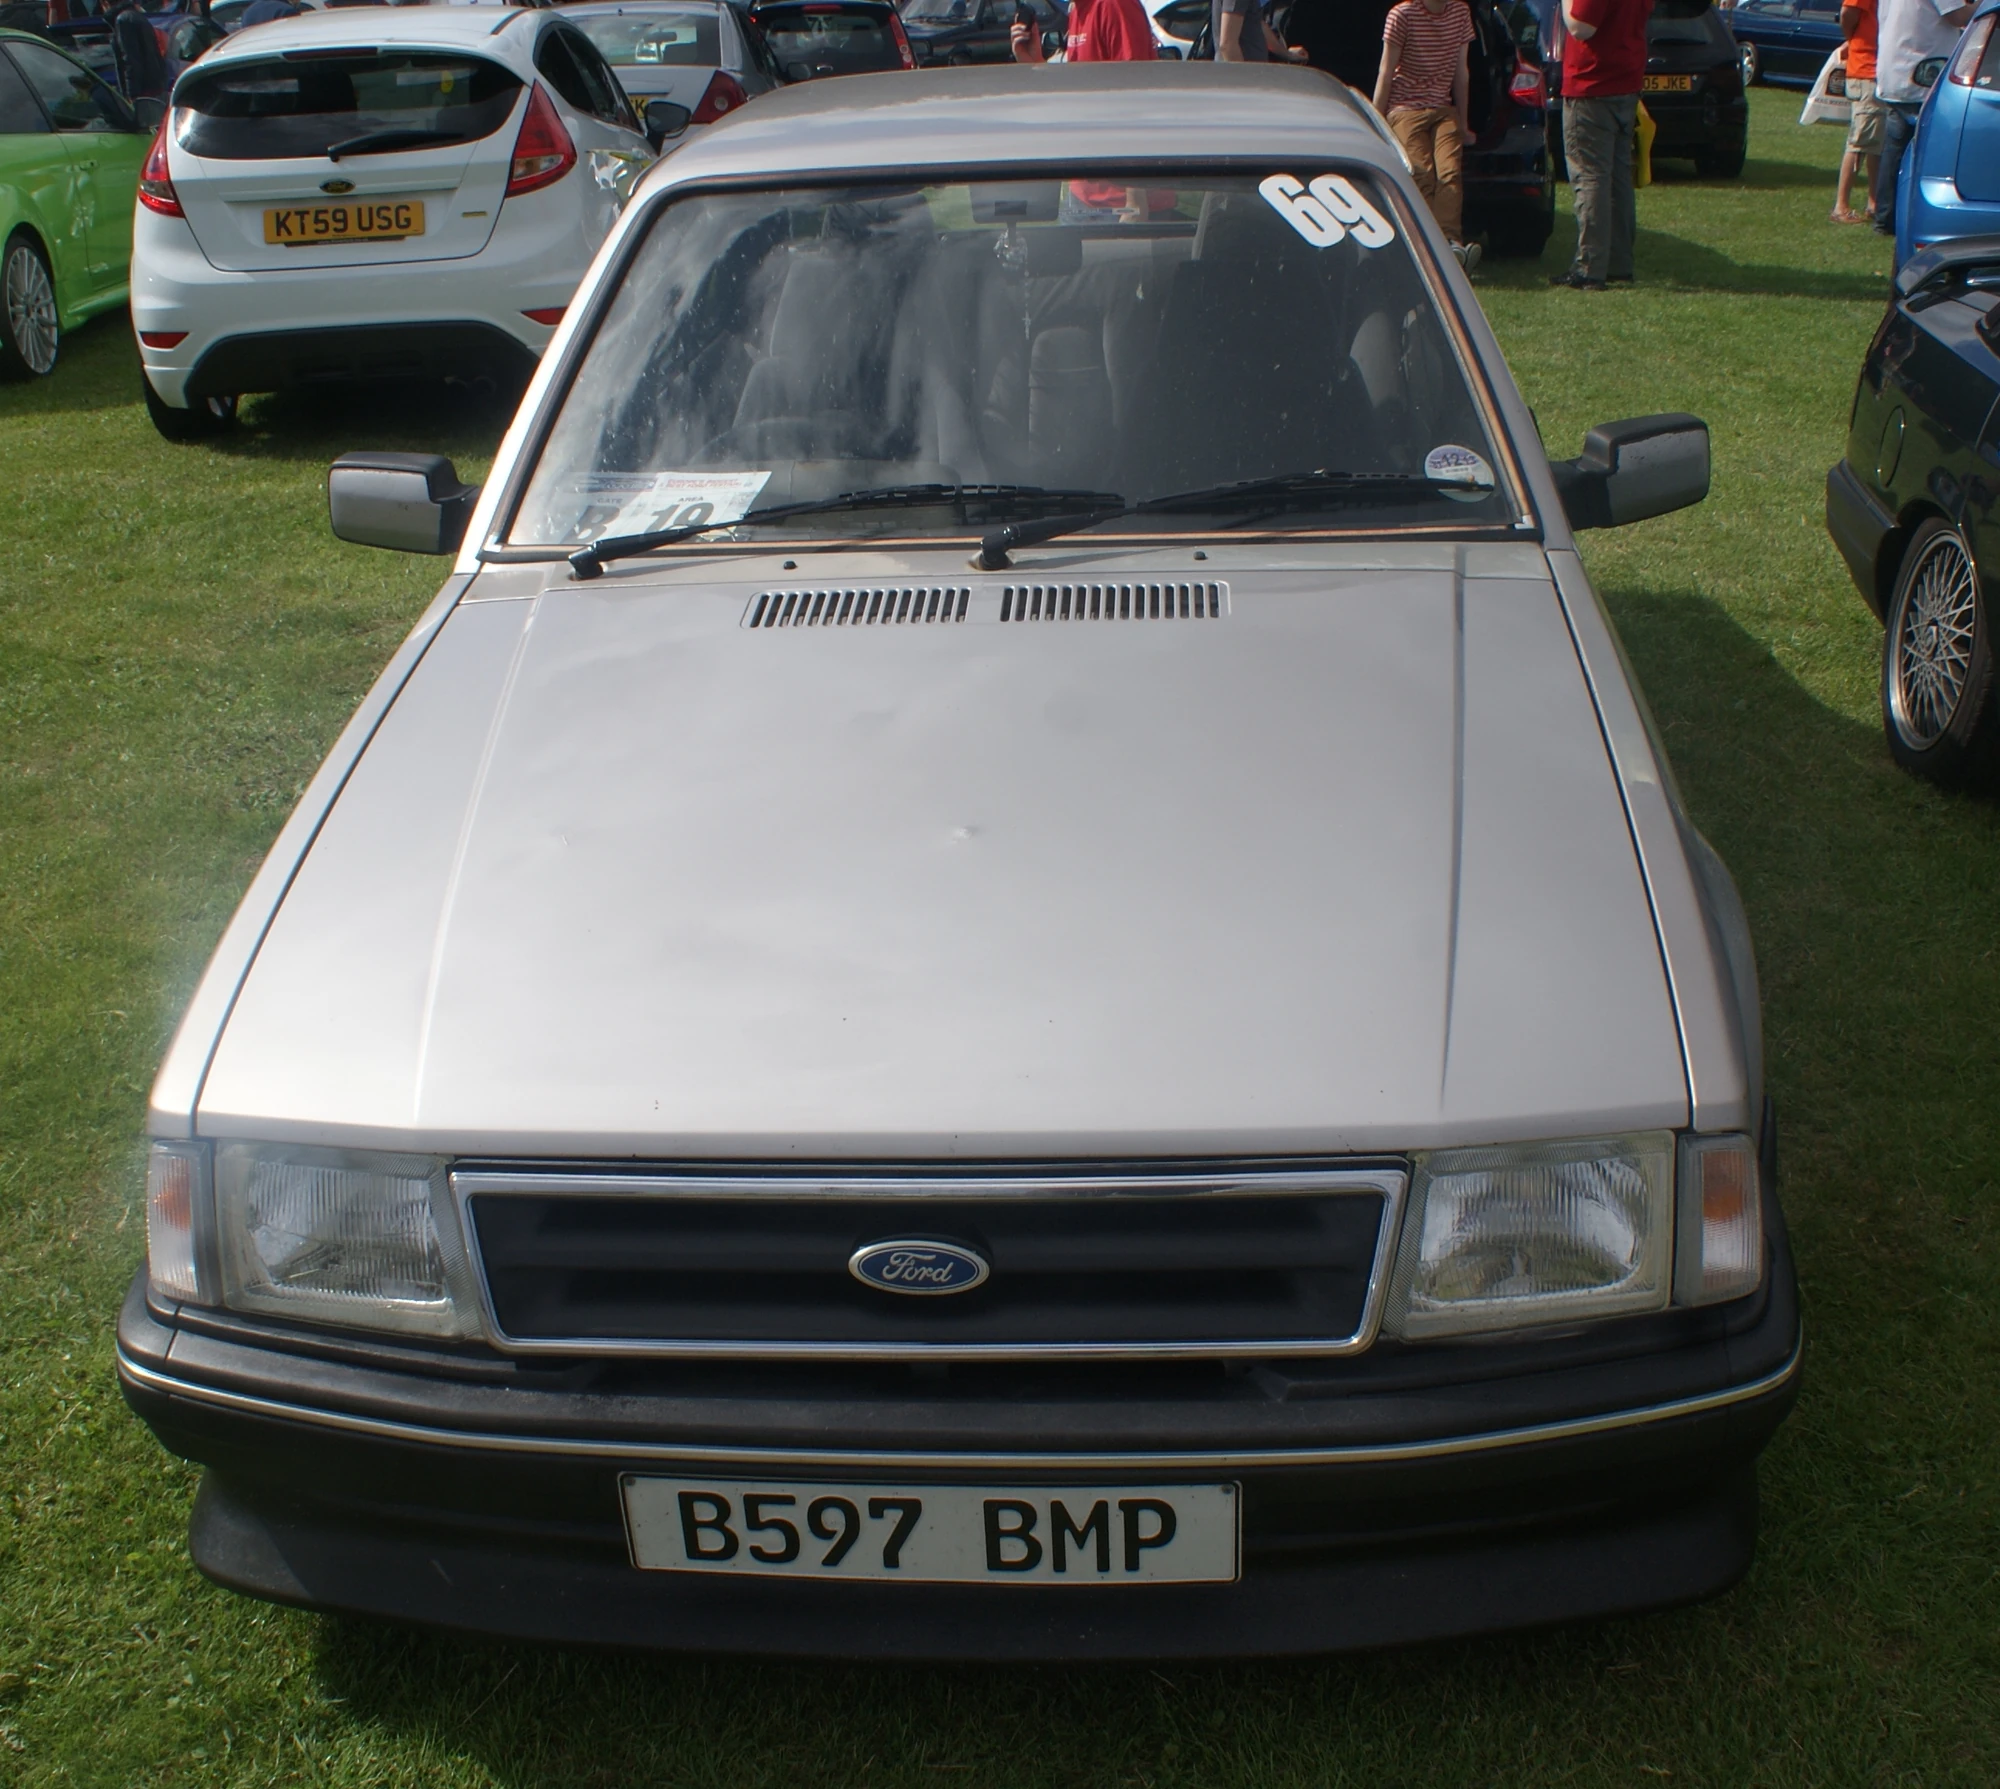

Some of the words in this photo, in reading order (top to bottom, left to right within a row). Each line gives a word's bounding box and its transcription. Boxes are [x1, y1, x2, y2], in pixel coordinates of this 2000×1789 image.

[1663, 77, 1687, 90] JKE
[275, 207, 348, 237] KT59
[357, 204, 412, 232] USG
[1258, 173, 1396, 249] 69
[677, 495, 704, 503] AREA
[882, 1251, 953, 1283] Ford
[677, 1490, 922, 1569] B597
[982, 1499, 1177, 1573] BMP
